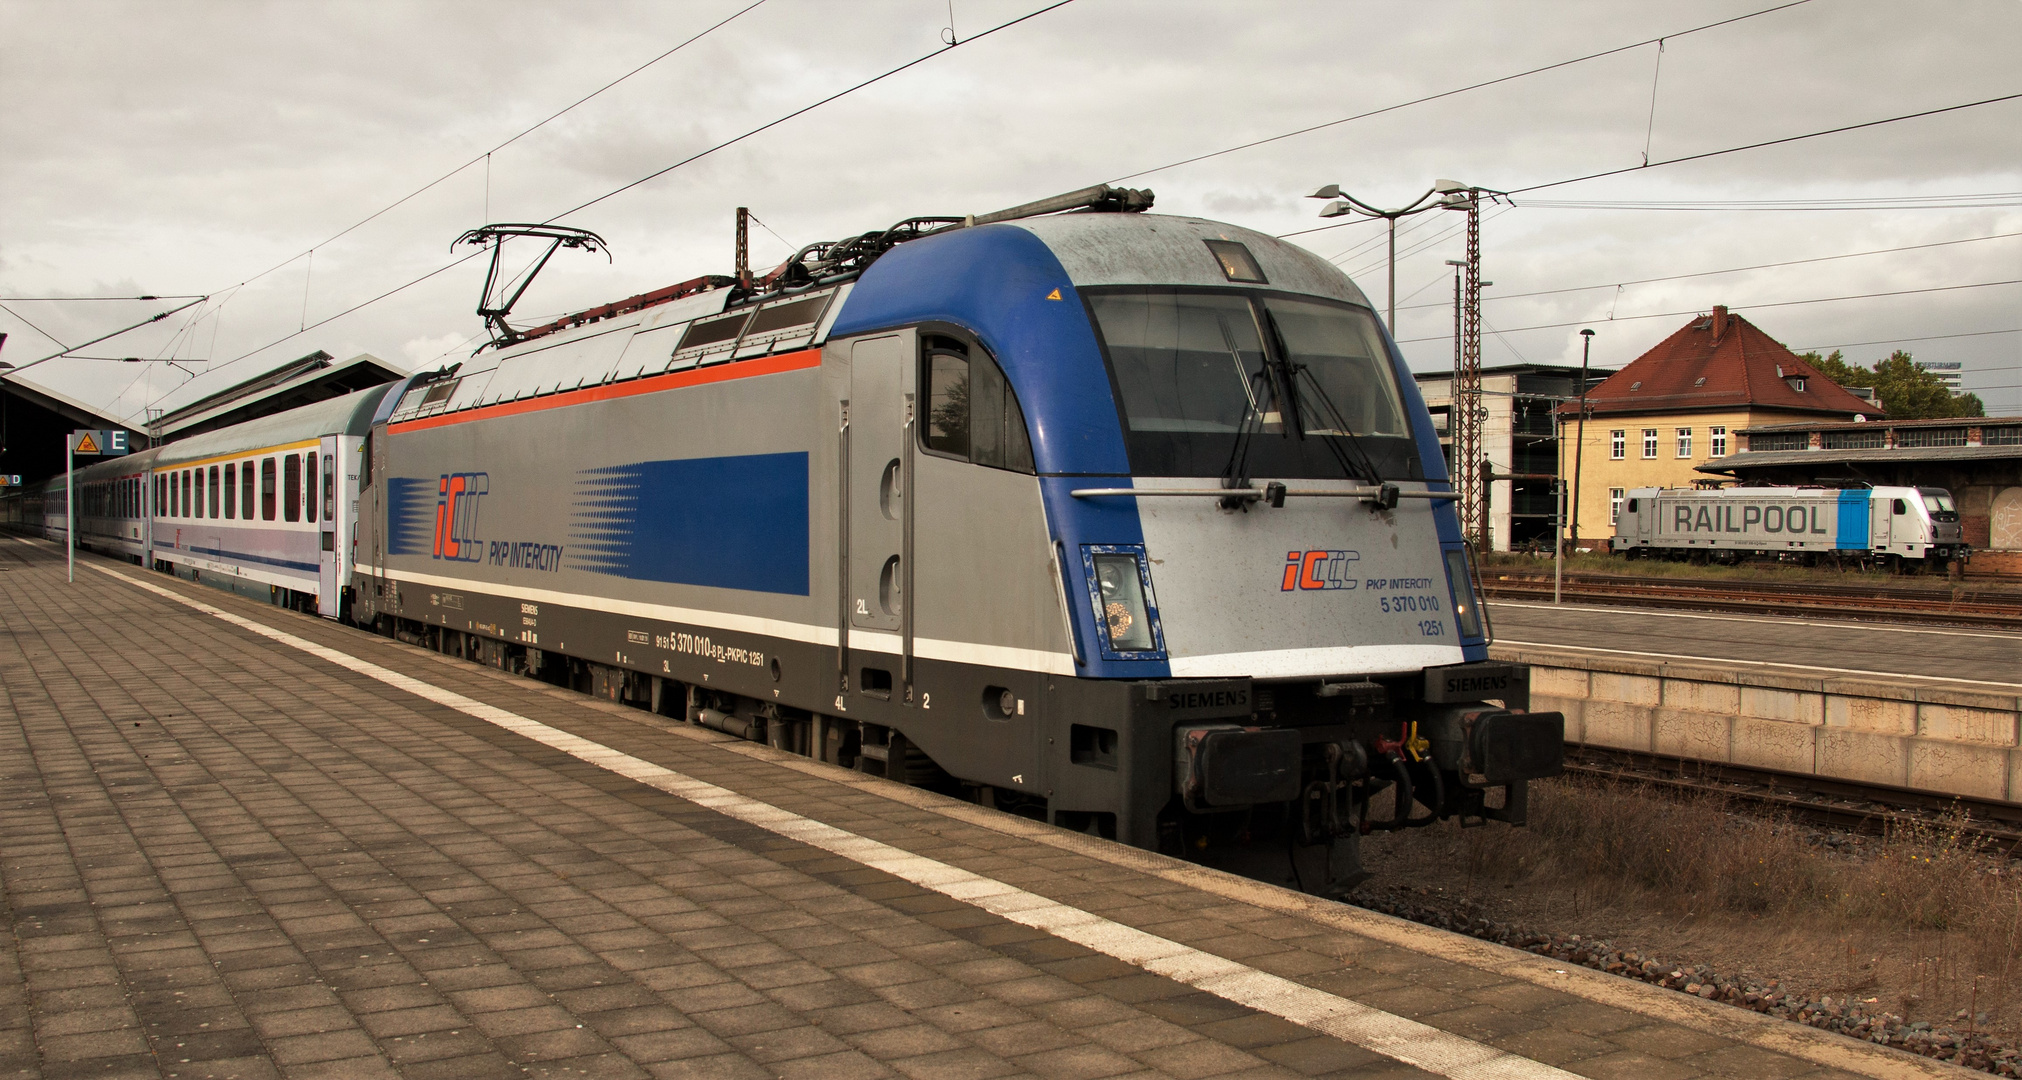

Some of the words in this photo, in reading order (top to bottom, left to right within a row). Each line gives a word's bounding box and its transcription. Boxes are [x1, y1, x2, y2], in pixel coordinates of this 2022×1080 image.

[112, 430, 125, 450] E
[12, 474, 21, 484] D
[1674, 505, 1827, 534] RAILPOOL
[489, 541, 510, 566] PKP
[509, 541, 564, 573] INTERCITY
[1365, 578, 1387, 590] PKP
[1389, 578, 1433, 590] INTERCITY
[521, 603, 538, 616] SIEMENS
[856, 599, 868, 615] 2L
[1380, 597, 1390, 613] 5
[1393, 596, 1417, 613] 370
[1418, 595, 1440, 612] 010
[1418, 620, 1444, 636] 1251
[655, 635, 662, 648] 91
[663, 636, 669, 649] 51
[670, 631, 676, 651] 5
[677, 632, 693, 654] 370
[748, 650, 764, 667] 1251
[663, 659, 671, 673] 3L
[1447, 675, 1507, 693] SIEMENS
[834, 695, 846, 711] 4L
[923, 692, 930, 709] 2
[1169, 690, 1247, 709] SIEMENS
